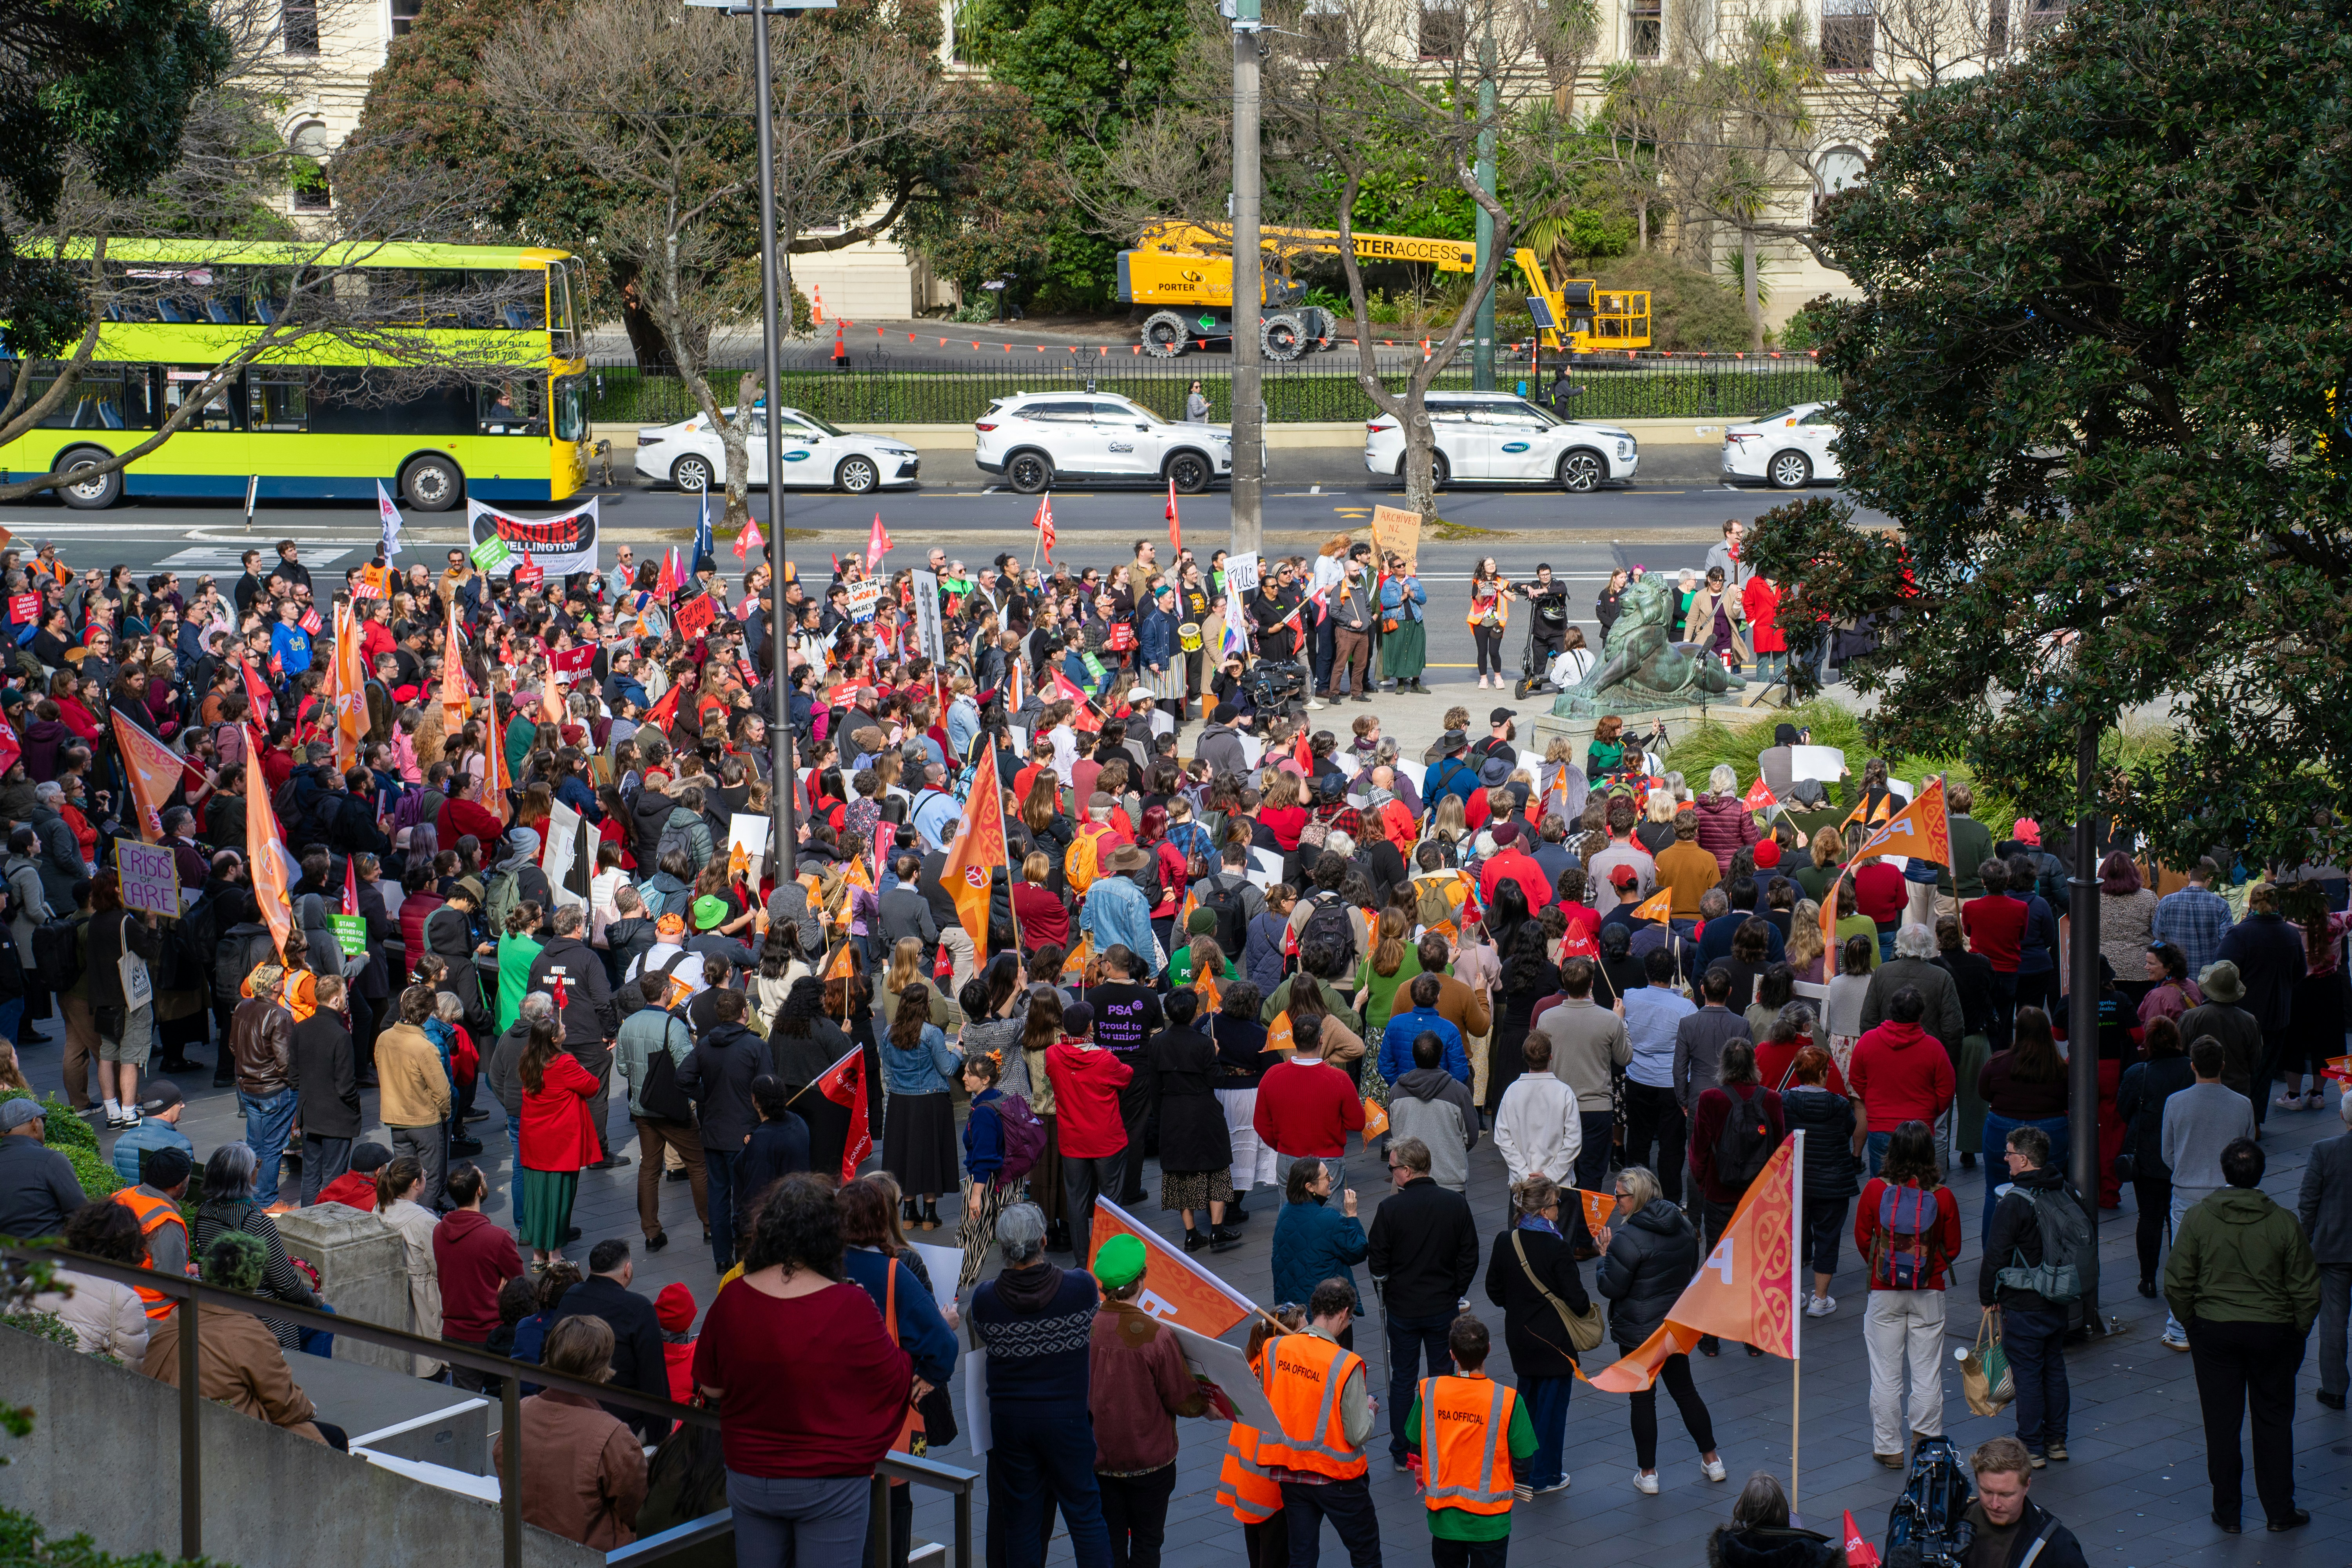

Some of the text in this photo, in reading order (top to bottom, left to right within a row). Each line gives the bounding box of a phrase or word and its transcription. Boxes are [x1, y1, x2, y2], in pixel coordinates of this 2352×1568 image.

[1380, 510, 1417, 527] ARCHIVES
[495, 517, 579, 544] UNIONS
[1388, 524, 1399, 535] NZ
[1227, 564, 1255, 589] FAIR
[852, 583, 862, 592] DO
[864, 579, 878, 589] THE
[19, 595, 34, 604] PUBLIC
[852, 589, 878, 602] WORK
[17, 601, 38, 610] SERVICES
[19, 606, 37, 615] MATTER
[679, 599, 705, 626] Fair PAY
[842, 685, 858, 693] STAND
[119, 847, 171, 880] CRISIS
[123, 880, 174, 913] CARE
[347, 936, 365, 945] SERVICES
[550, 965, 566, 975] MUNZ
[1181, 968, 1191, 978] PS
[543, 975, 575, 985] Wellgton
[1108, 1005, 1132, 1016] PSA
[1099, 1021, 1129, 1031] Proud
[1100, 1030, 1141, 1041] be union
[835, 1072, 857, 1095] Te Kau
[848, 1134, 869, 1166] COUNCIL
[1278, 1360, 1320, 1383] PSA OFFICIAL
[1201, 1385, 1220, 1395] VICE
[1438, 1409, 1485, 1425] PSA OFFICIAL
